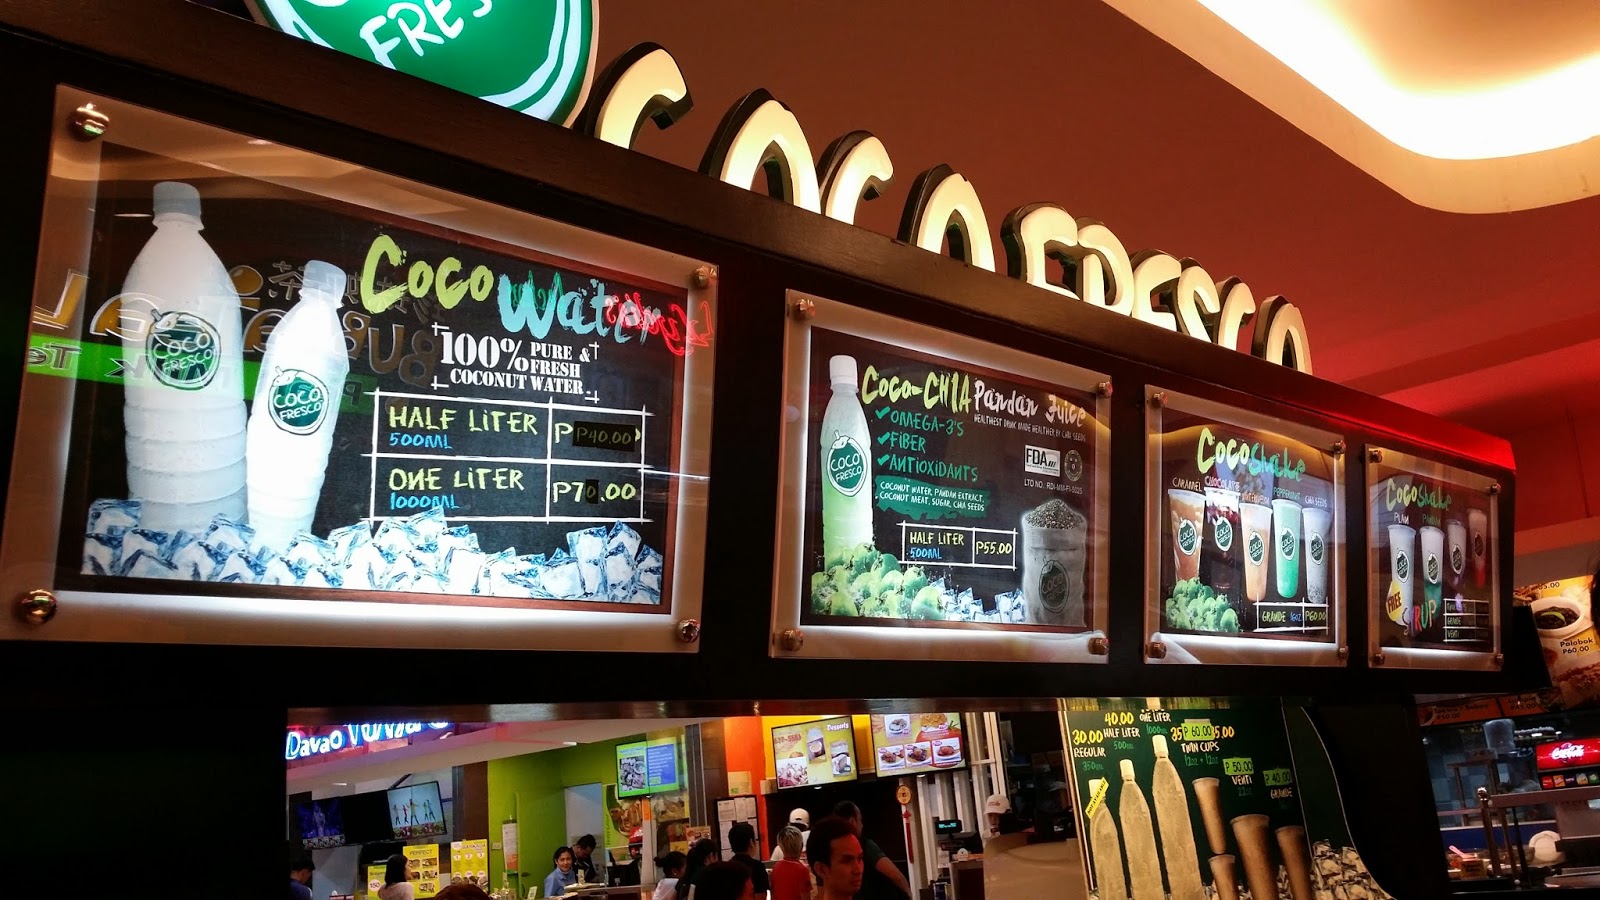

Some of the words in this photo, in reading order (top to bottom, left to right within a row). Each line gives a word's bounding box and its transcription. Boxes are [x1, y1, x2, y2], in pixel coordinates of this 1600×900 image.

[360, 234, 494, 314] Coco
[497, 272, 661, 344] Water
[153, 332, 211, 360] COCO
[440, 330, 529, 372] 100%
[530, 341, 573, 360] PURE
[579, 347, 591, 363] &
[162, 349, 213, 372] FRESCO
[530, 360, 581, 378] FRESH
[450, 368, 527, 390] COCONUT
[530, 376, 584, 395] WATER
[274, 388, 321, 408] COCO
[974, 378, 1039, 418] Pandan
[1045, 394, 1086, 427] Juice
[279, 401, 323, 422] FRESCO
[389, 406, 457, 431] HALF
[469, 410, 538, 435] LITER
[890, 409, 964, 437] OMEGA-3'S
[389, 432, 453, 450] 500ML
[575, 427, 632, 445] P40.00
[889, 432, 926, 453] FIBER
[1026, 448, 1047, 466] FDA
[1196, 427, 1249, 473] Coco
[830, 453, 861, 472] COCO
[889, 456, 978, 483] ANTIOXIDANTS
[389, 468, 442, 491] ONE
[454, 468, 524, 490] LITER
[835, 466, 863, 482] FRESCO
[553, 481, 636, 503] P70.00
[880, 481, 910, 493] COCONUT
[934, 489, 957, 499] PANDAN
[1172, 477, 1202, 492] CARAMEL
[1205, 475, 1240, 492] CHOCOLATE
[390, 492, 460, 510] 1000ML
[880, 491, 909, 502] COCONUT
[953, 500, 966, 509] CHIA
[967, 503, 985, 512] SEEDS
[1386, 478, 1417, 511] Coco
[910, 532, 934, 545] HALF
[938, 532, 965, 546] LITER
[976, 540, 1012, 556] P55.00
[910, 547, 942, 560] 500ML
[1387, 591, 1401, 614] FREE
[1262, 610, 1286, 622] GRANDE
[1560, 637, 1593, 647] Palabok
[1562, 645, 1589, 655] P60.00
[1104, 712, 1134, 726] 40.00
[1139, 712, 1152, 722] ONE
[1153, 712, 1171, 722] LITER
[1072, 729, 1104, 745] 30.00
[1103, 728, 1120, 738] HALF
[1121, 727, 1140, 738] LITER
[1192, 725, 1212, 737] 60.00
[285, 730, 342, 760] Davao
[1073, 747, 1106, 758] REGULAR
[1181, 742, 1198, 754] TWIN
[1200, 741, 1220, 753] CUPS
[1233, 761, 1253, 772] 50.00
[1231, 775, 1253, 786] VENTI
[1272, 771, 1291, 784] 40.00
[409, 849, 433, 857] PERFECT
